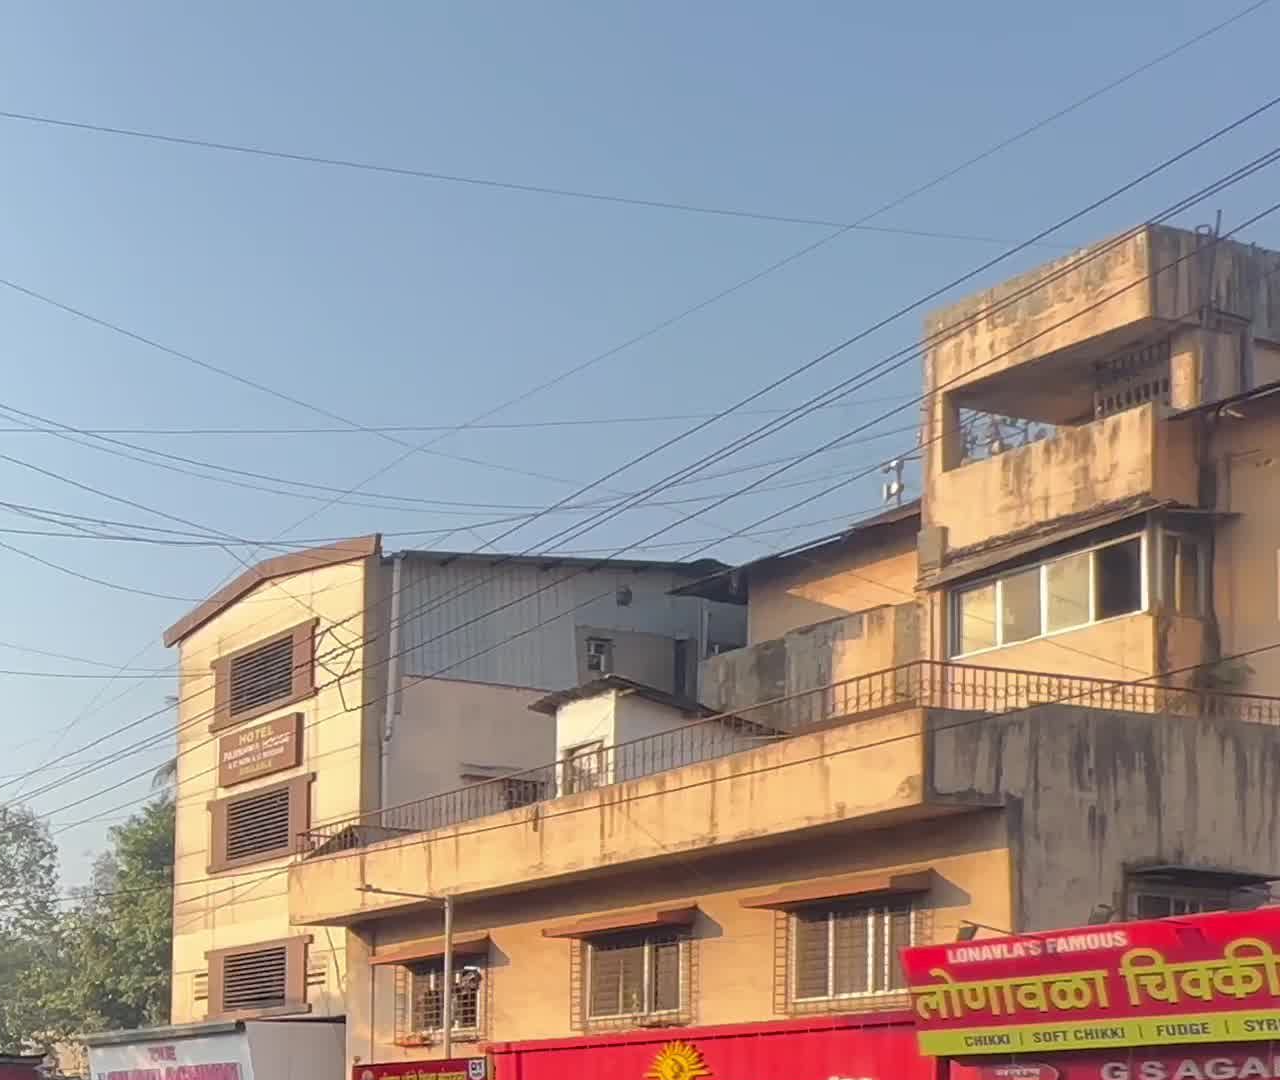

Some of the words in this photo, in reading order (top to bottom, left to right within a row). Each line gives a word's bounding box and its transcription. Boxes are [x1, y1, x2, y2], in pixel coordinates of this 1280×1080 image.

[947, 940, 1041, 964] LONAVLA'S
[1045, 930, 1128, 953] FAMOUS
[915, 968, 1110, 1020] लोणावळा
[964, 1033, 1010, 1048] CHIKKI
[1032, 1030, 1068, 1044] SOFT
[1074, 1027, 1126, 1041] CHIKKI
[1156, 1022, 1211, 1037] FUDGE
